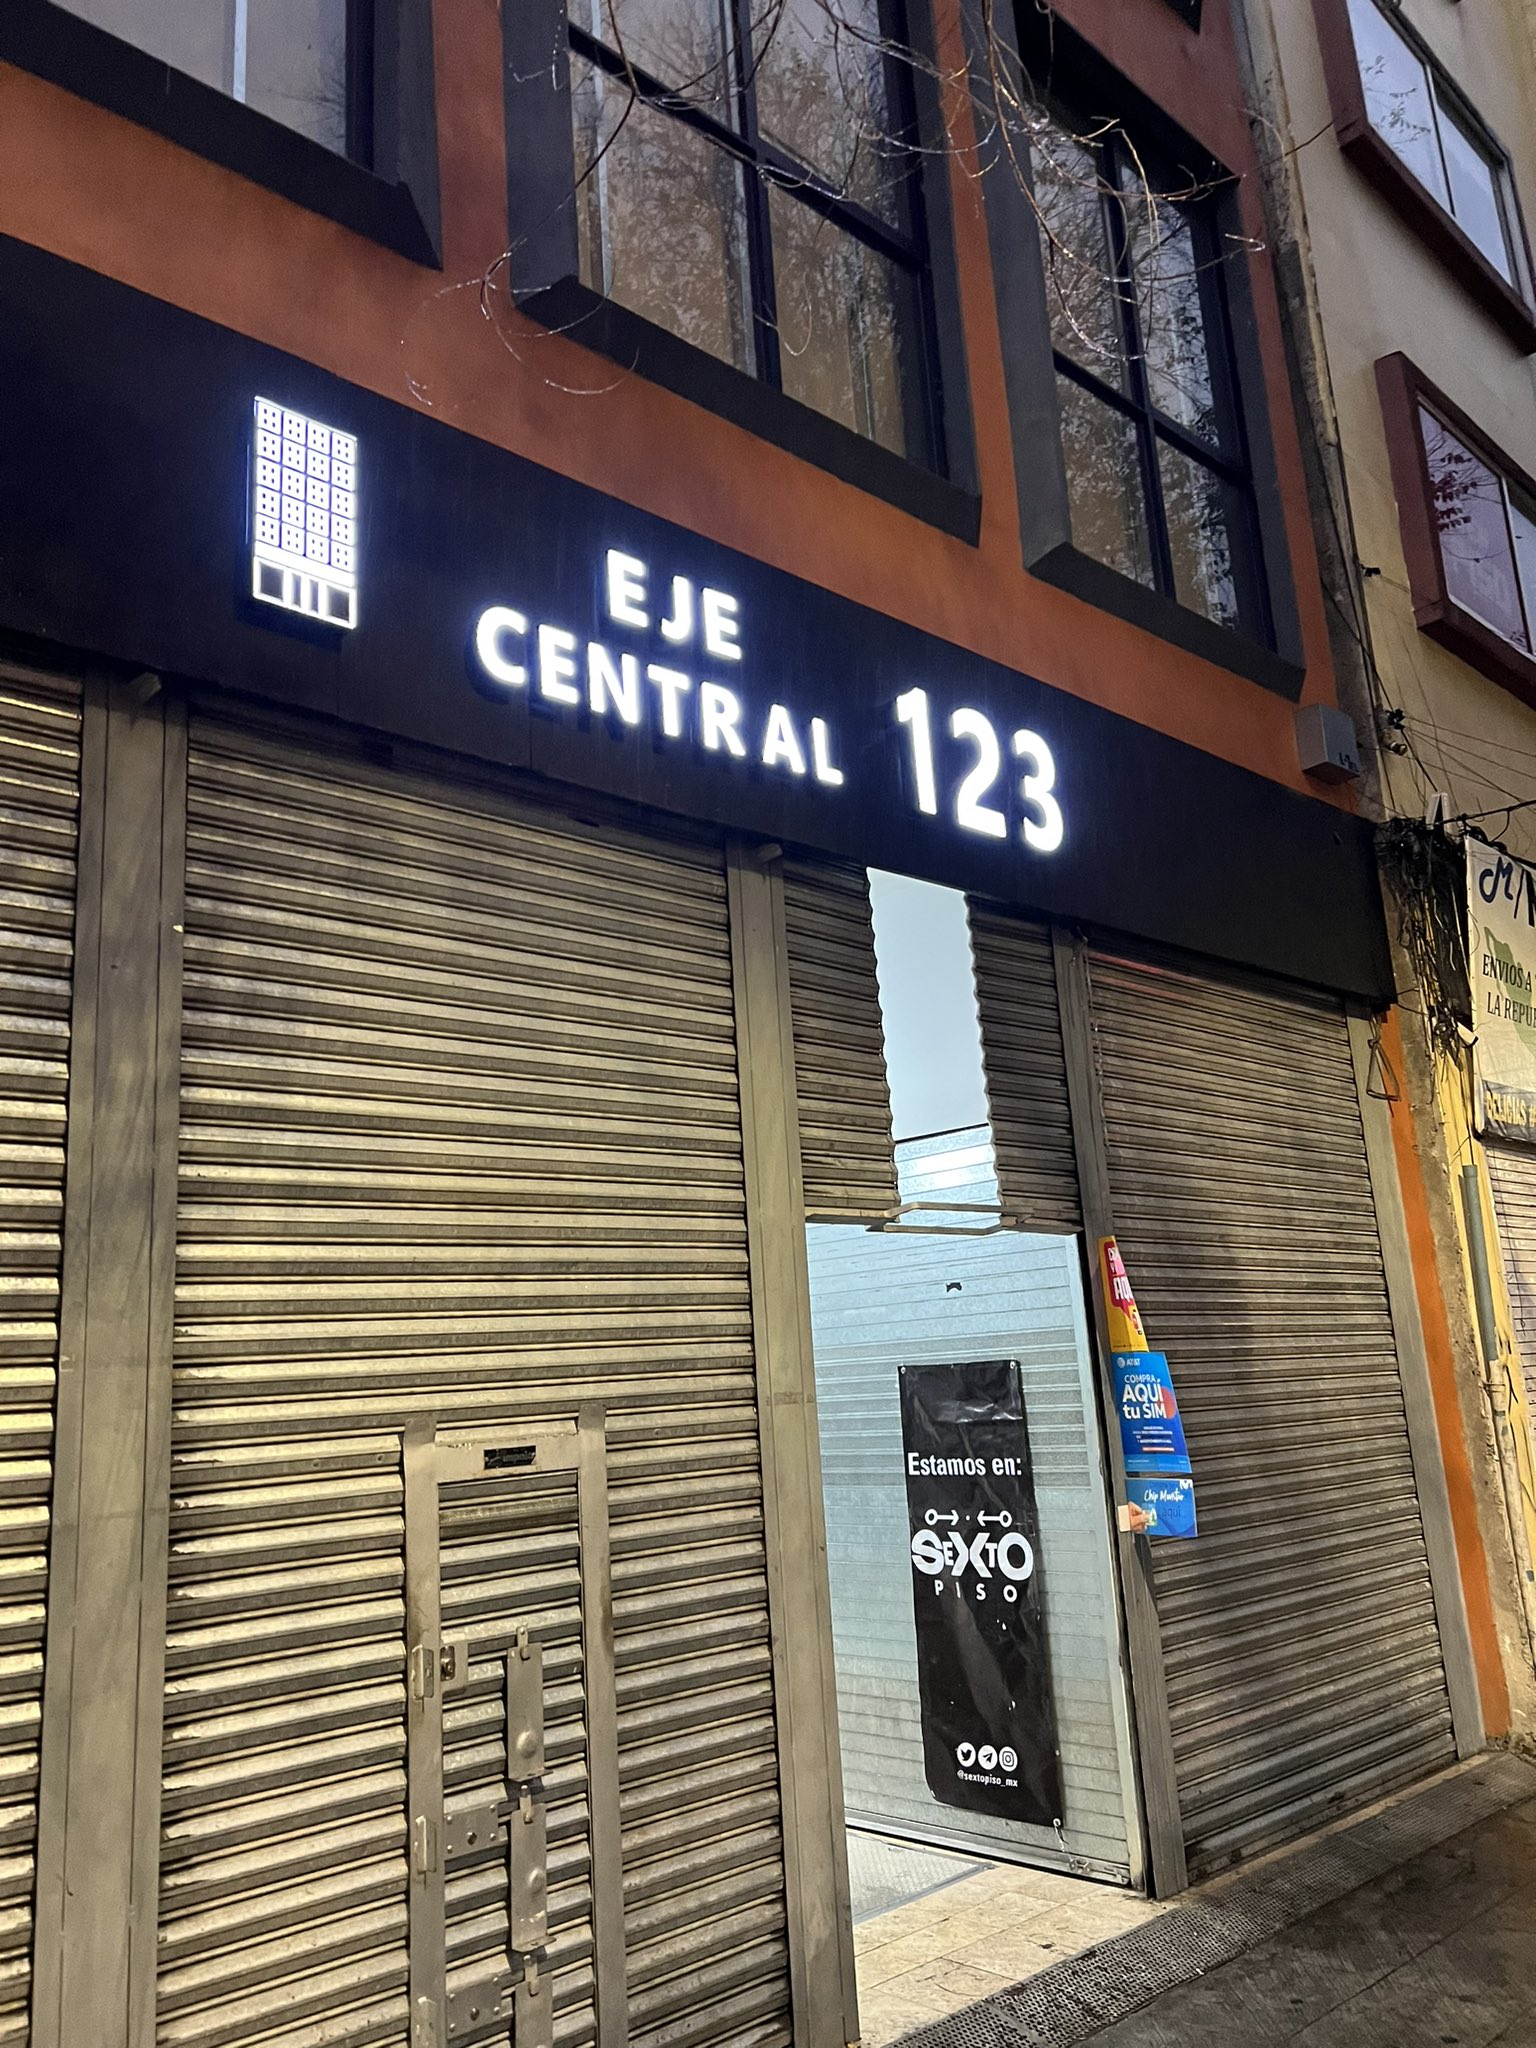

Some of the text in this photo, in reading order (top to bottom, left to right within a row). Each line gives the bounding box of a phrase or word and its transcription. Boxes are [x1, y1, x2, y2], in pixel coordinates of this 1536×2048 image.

[606, 548, 742, 660] EJE
[475, 606, 843, 786] CENTRAL
[896, 687, 1064, 852] 123
[1482, 953, 1532, 992] ENVIOS A
[1487, 991, 1501, 1016] LA
[1122, 1378, 1164, 1403] AQUÍ
[1124, 1374, 1156, 1383] COMPRA
[1122, 1402, 1167, 1419] tu SIM
[907, 1452, 1022, 1476] Estamos en:
[1144, 1488, 1159, 1503] Chip
[911, 1529, 1034, 1581] SEXTO
[934, 1579, 1018, 1602] PISO
[956, 1769, 1018, 1788] @sextopiso_mx
